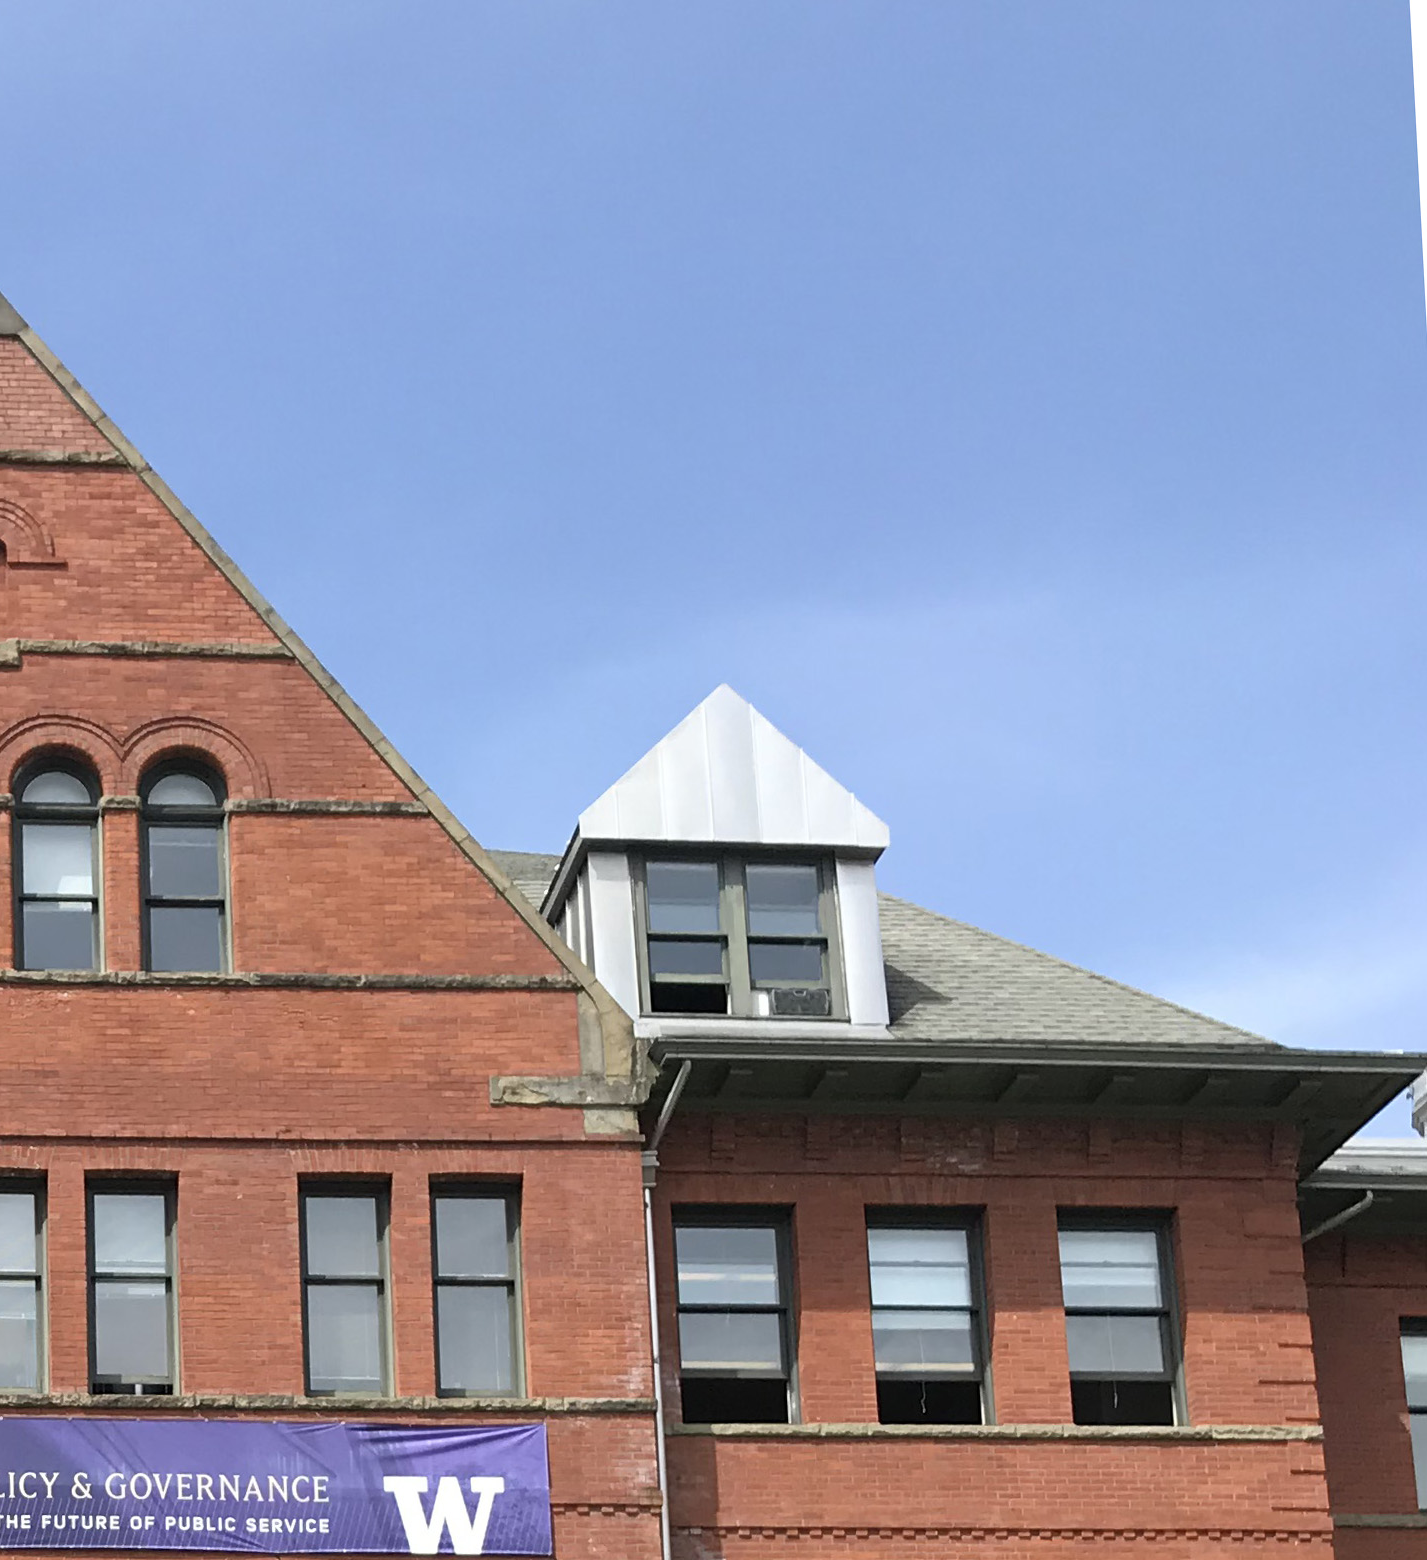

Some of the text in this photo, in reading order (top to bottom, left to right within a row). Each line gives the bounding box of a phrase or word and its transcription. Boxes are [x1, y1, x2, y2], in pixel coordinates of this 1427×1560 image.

[71, 1471, 93, 1499] &
[104, 1472, 330, 1503] GOVERNANCE
[41, 1514, 120, 1530] FUTURE
[129, 1515, 155, 1531] OF
[165, 1516, 236, 1532] PUBLIC
[245, 1517, 330, 1534] SERVICE
[383, 1476, 505, 1555] W
